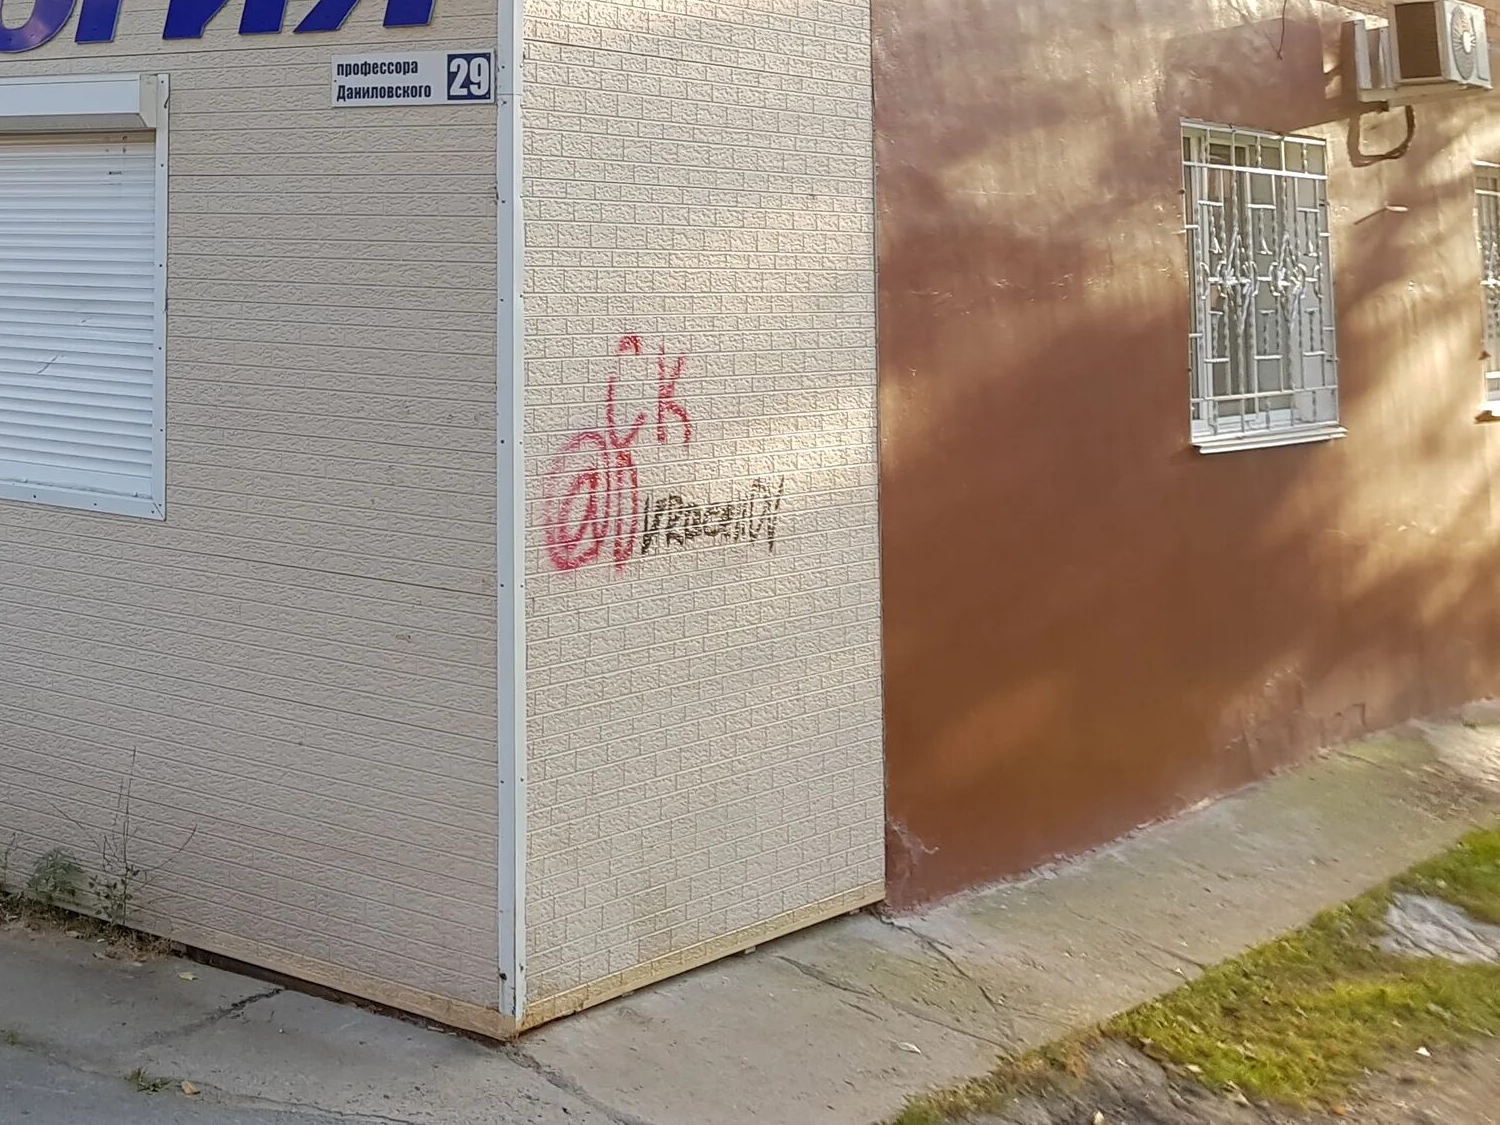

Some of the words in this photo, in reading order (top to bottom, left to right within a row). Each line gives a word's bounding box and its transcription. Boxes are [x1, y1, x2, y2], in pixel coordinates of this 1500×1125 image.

[336, 60, 419, 77] профессора
[449, 56, 490, 96] 29
[336, 84, 432, 102] Даниловского
